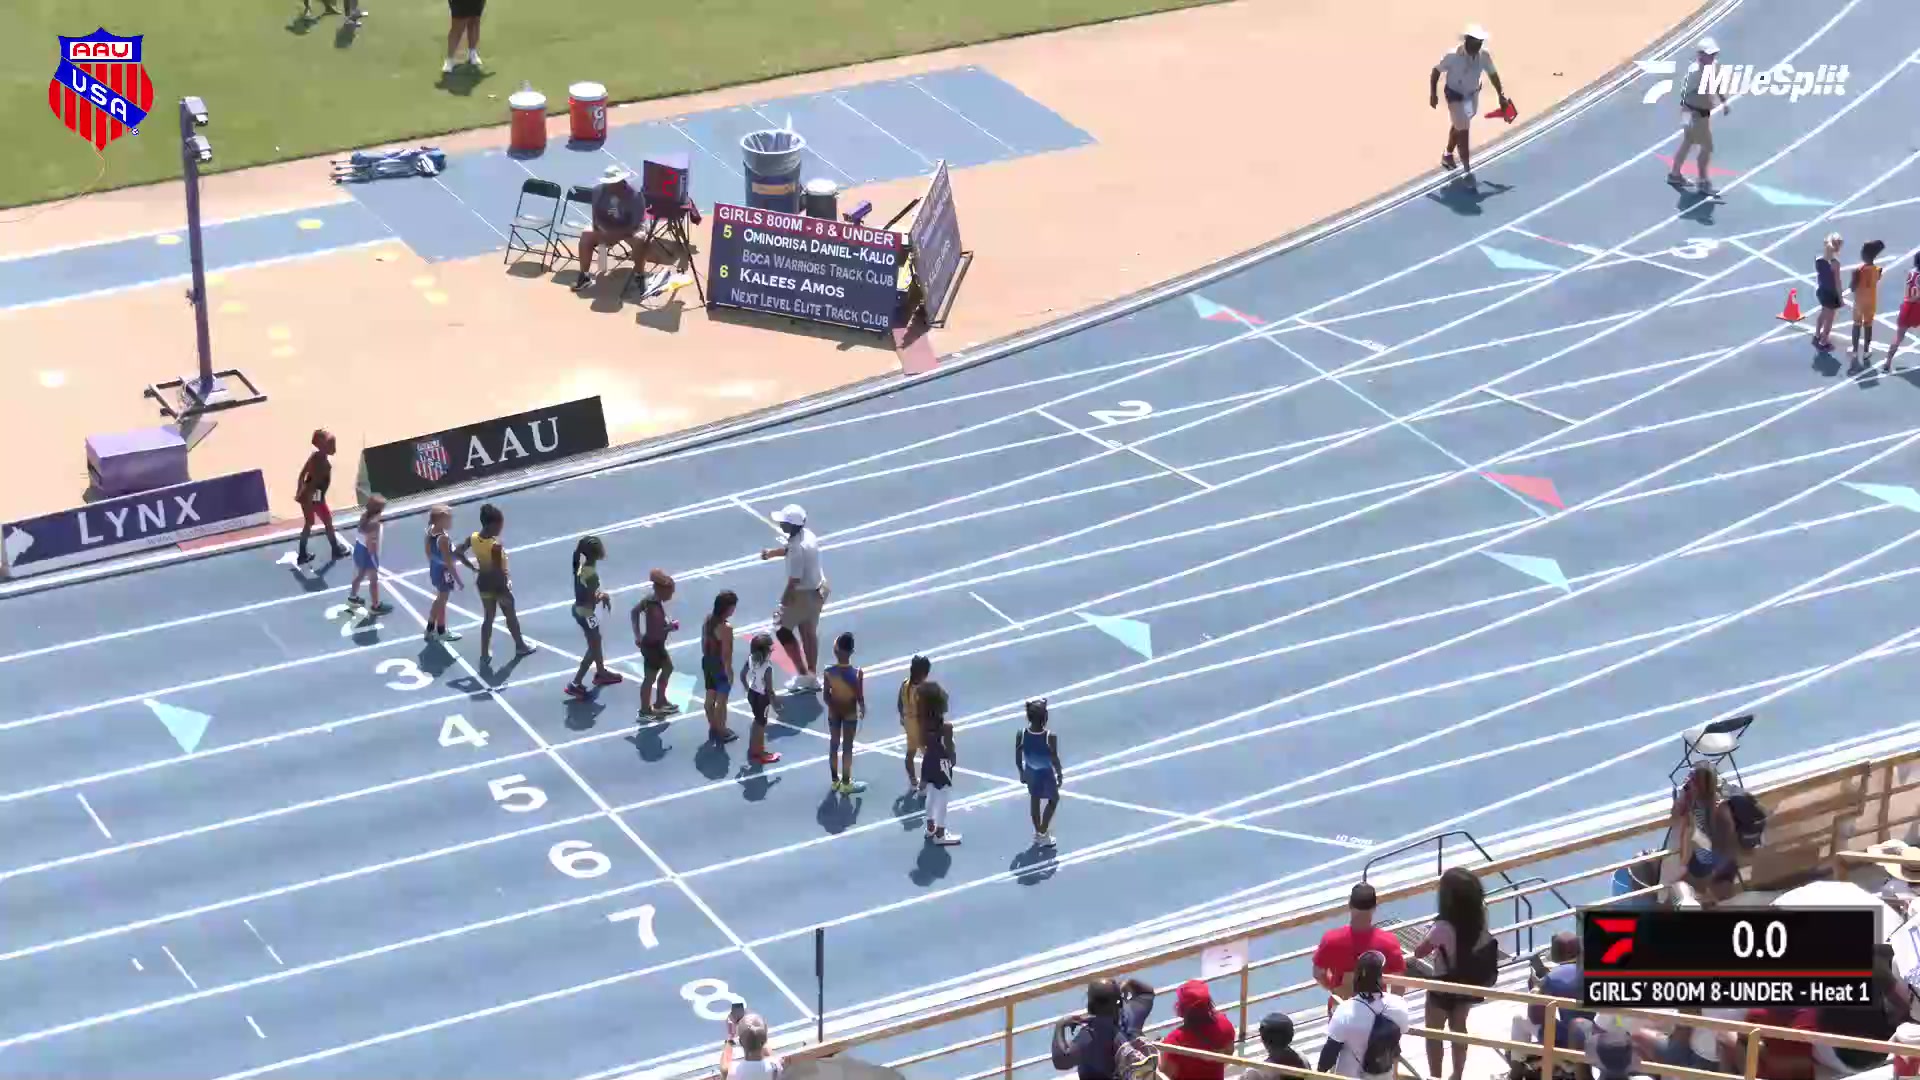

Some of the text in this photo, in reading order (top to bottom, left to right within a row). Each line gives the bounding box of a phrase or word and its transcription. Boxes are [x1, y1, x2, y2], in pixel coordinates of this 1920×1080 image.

[719, 206, 763, 225] GIRLS
[766, 214, 803, 232] 800M
[815, 222, 824, 235] 8
[827, 224, 838, 237] &
[842, 226, 895, 246] UNDER
[723, 224, 732, 239] 5
[719, 264, 729, 278] 6
[1087, 400, 1153, 425] 2
[464, 416, 559, 470] AAU
[77, 492, 201, 545] LYNX
[324, 603, 385, 637] 2
[375, 658, 435, 691] 3
[437, 713, 490, 748] 4
[487, 773, 549, 812] 5
[547, 839, 612, 879] 6
[607, 904, 660, 950] 7
[679, 978, 748, 1021] 8
